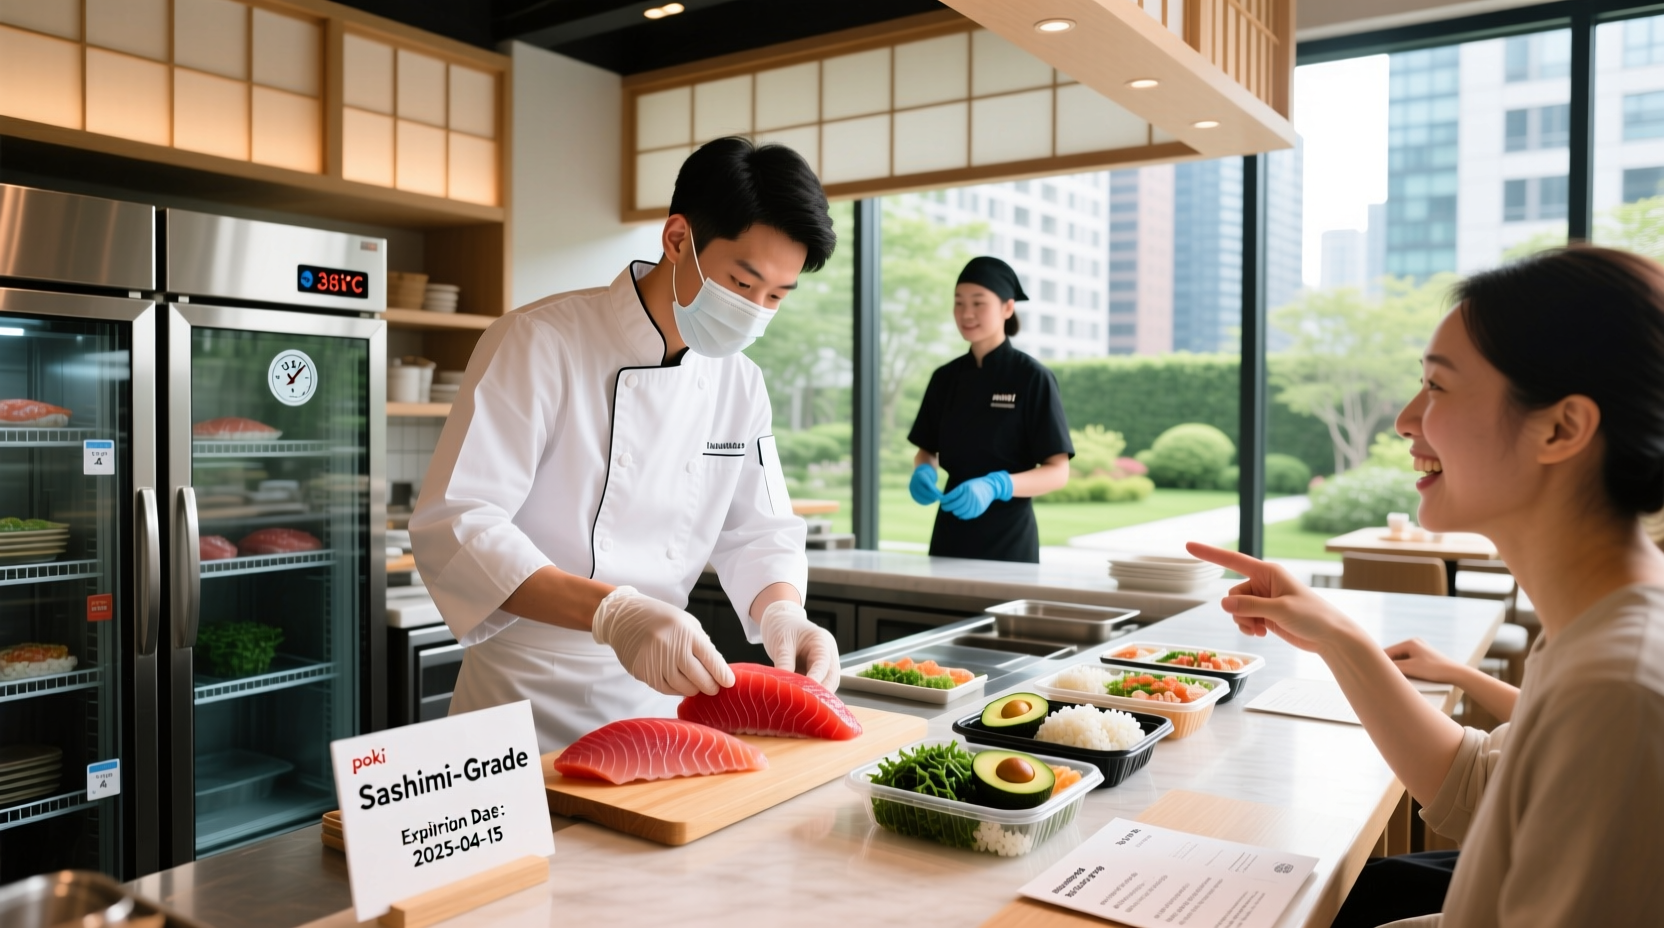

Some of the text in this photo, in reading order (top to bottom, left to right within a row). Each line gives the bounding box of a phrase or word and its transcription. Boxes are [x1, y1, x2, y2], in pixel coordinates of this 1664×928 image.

[352, 748, 386, 774] poki
[358, 747, 529, 810] Sashimi-Grade
[412, 825, 504, 868] 2025-04-15
